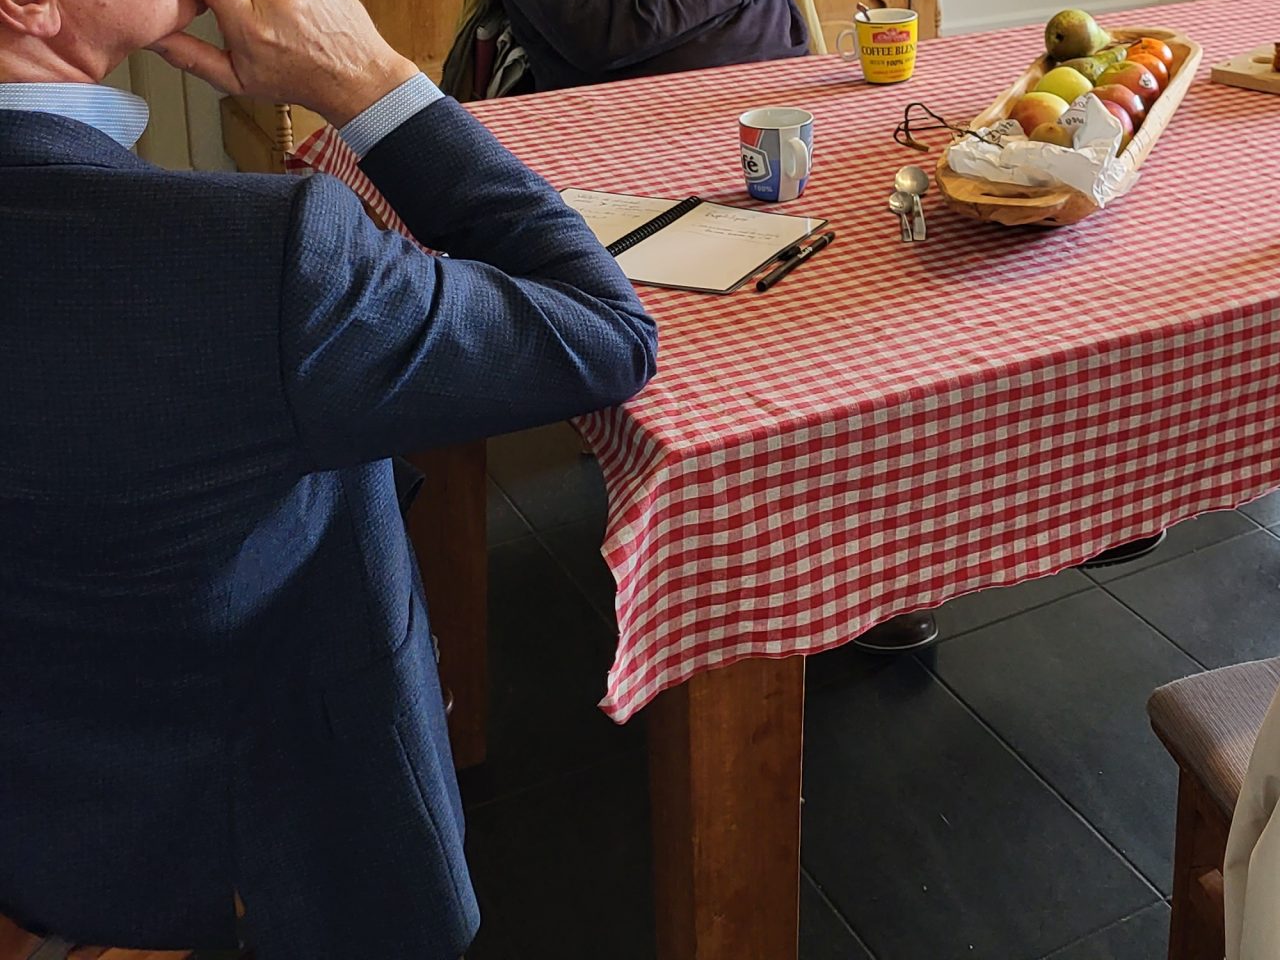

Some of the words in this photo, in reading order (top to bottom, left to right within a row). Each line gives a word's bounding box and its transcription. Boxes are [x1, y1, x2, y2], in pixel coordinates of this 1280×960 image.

[861, 46, 893, 56] COFFEE
[895, 44, 914, 56] BLEN
[742, 153, 759, 174] fé
